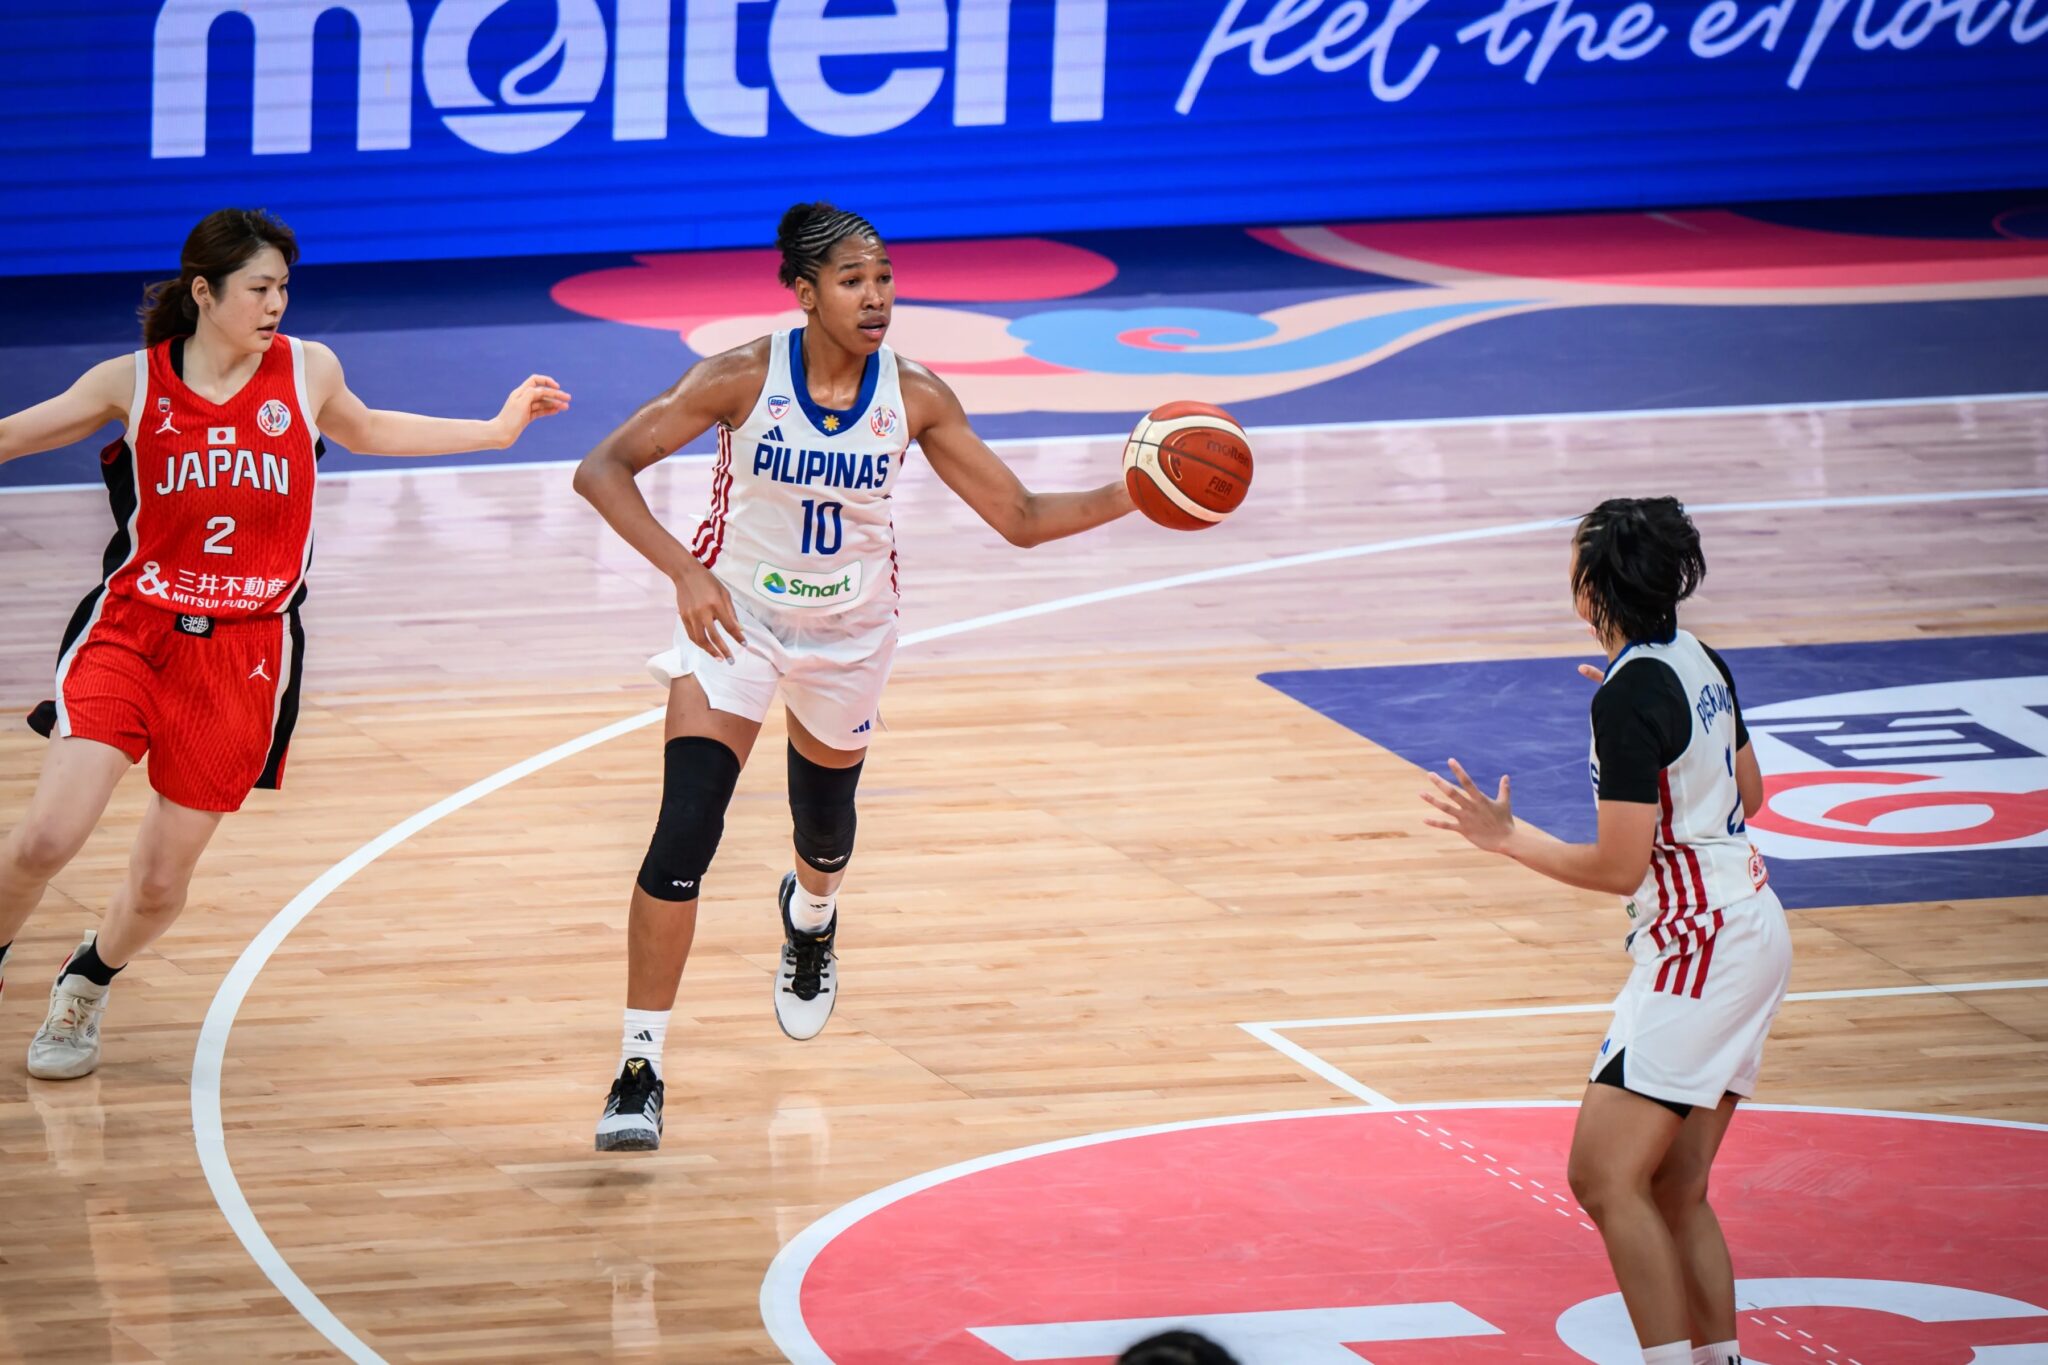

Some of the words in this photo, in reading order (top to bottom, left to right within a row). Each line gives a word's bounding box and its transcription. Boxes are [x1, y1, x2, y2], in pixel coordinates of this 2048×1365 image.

[151, 0, 1106, 159] molten
[155, 448, 289, 496] JAPAN
[753, 442, 890, 490] PILIPINAS
[1208, 475, 1234, 497] FIBA
[203, 515, 237, 555] 2
[800, 499, 843, 556] 10
[171, 591, 219, 609] MITSUI
[174, 568, 288, 599] 三井不動産
[788, 574, 851, 598] Smart
